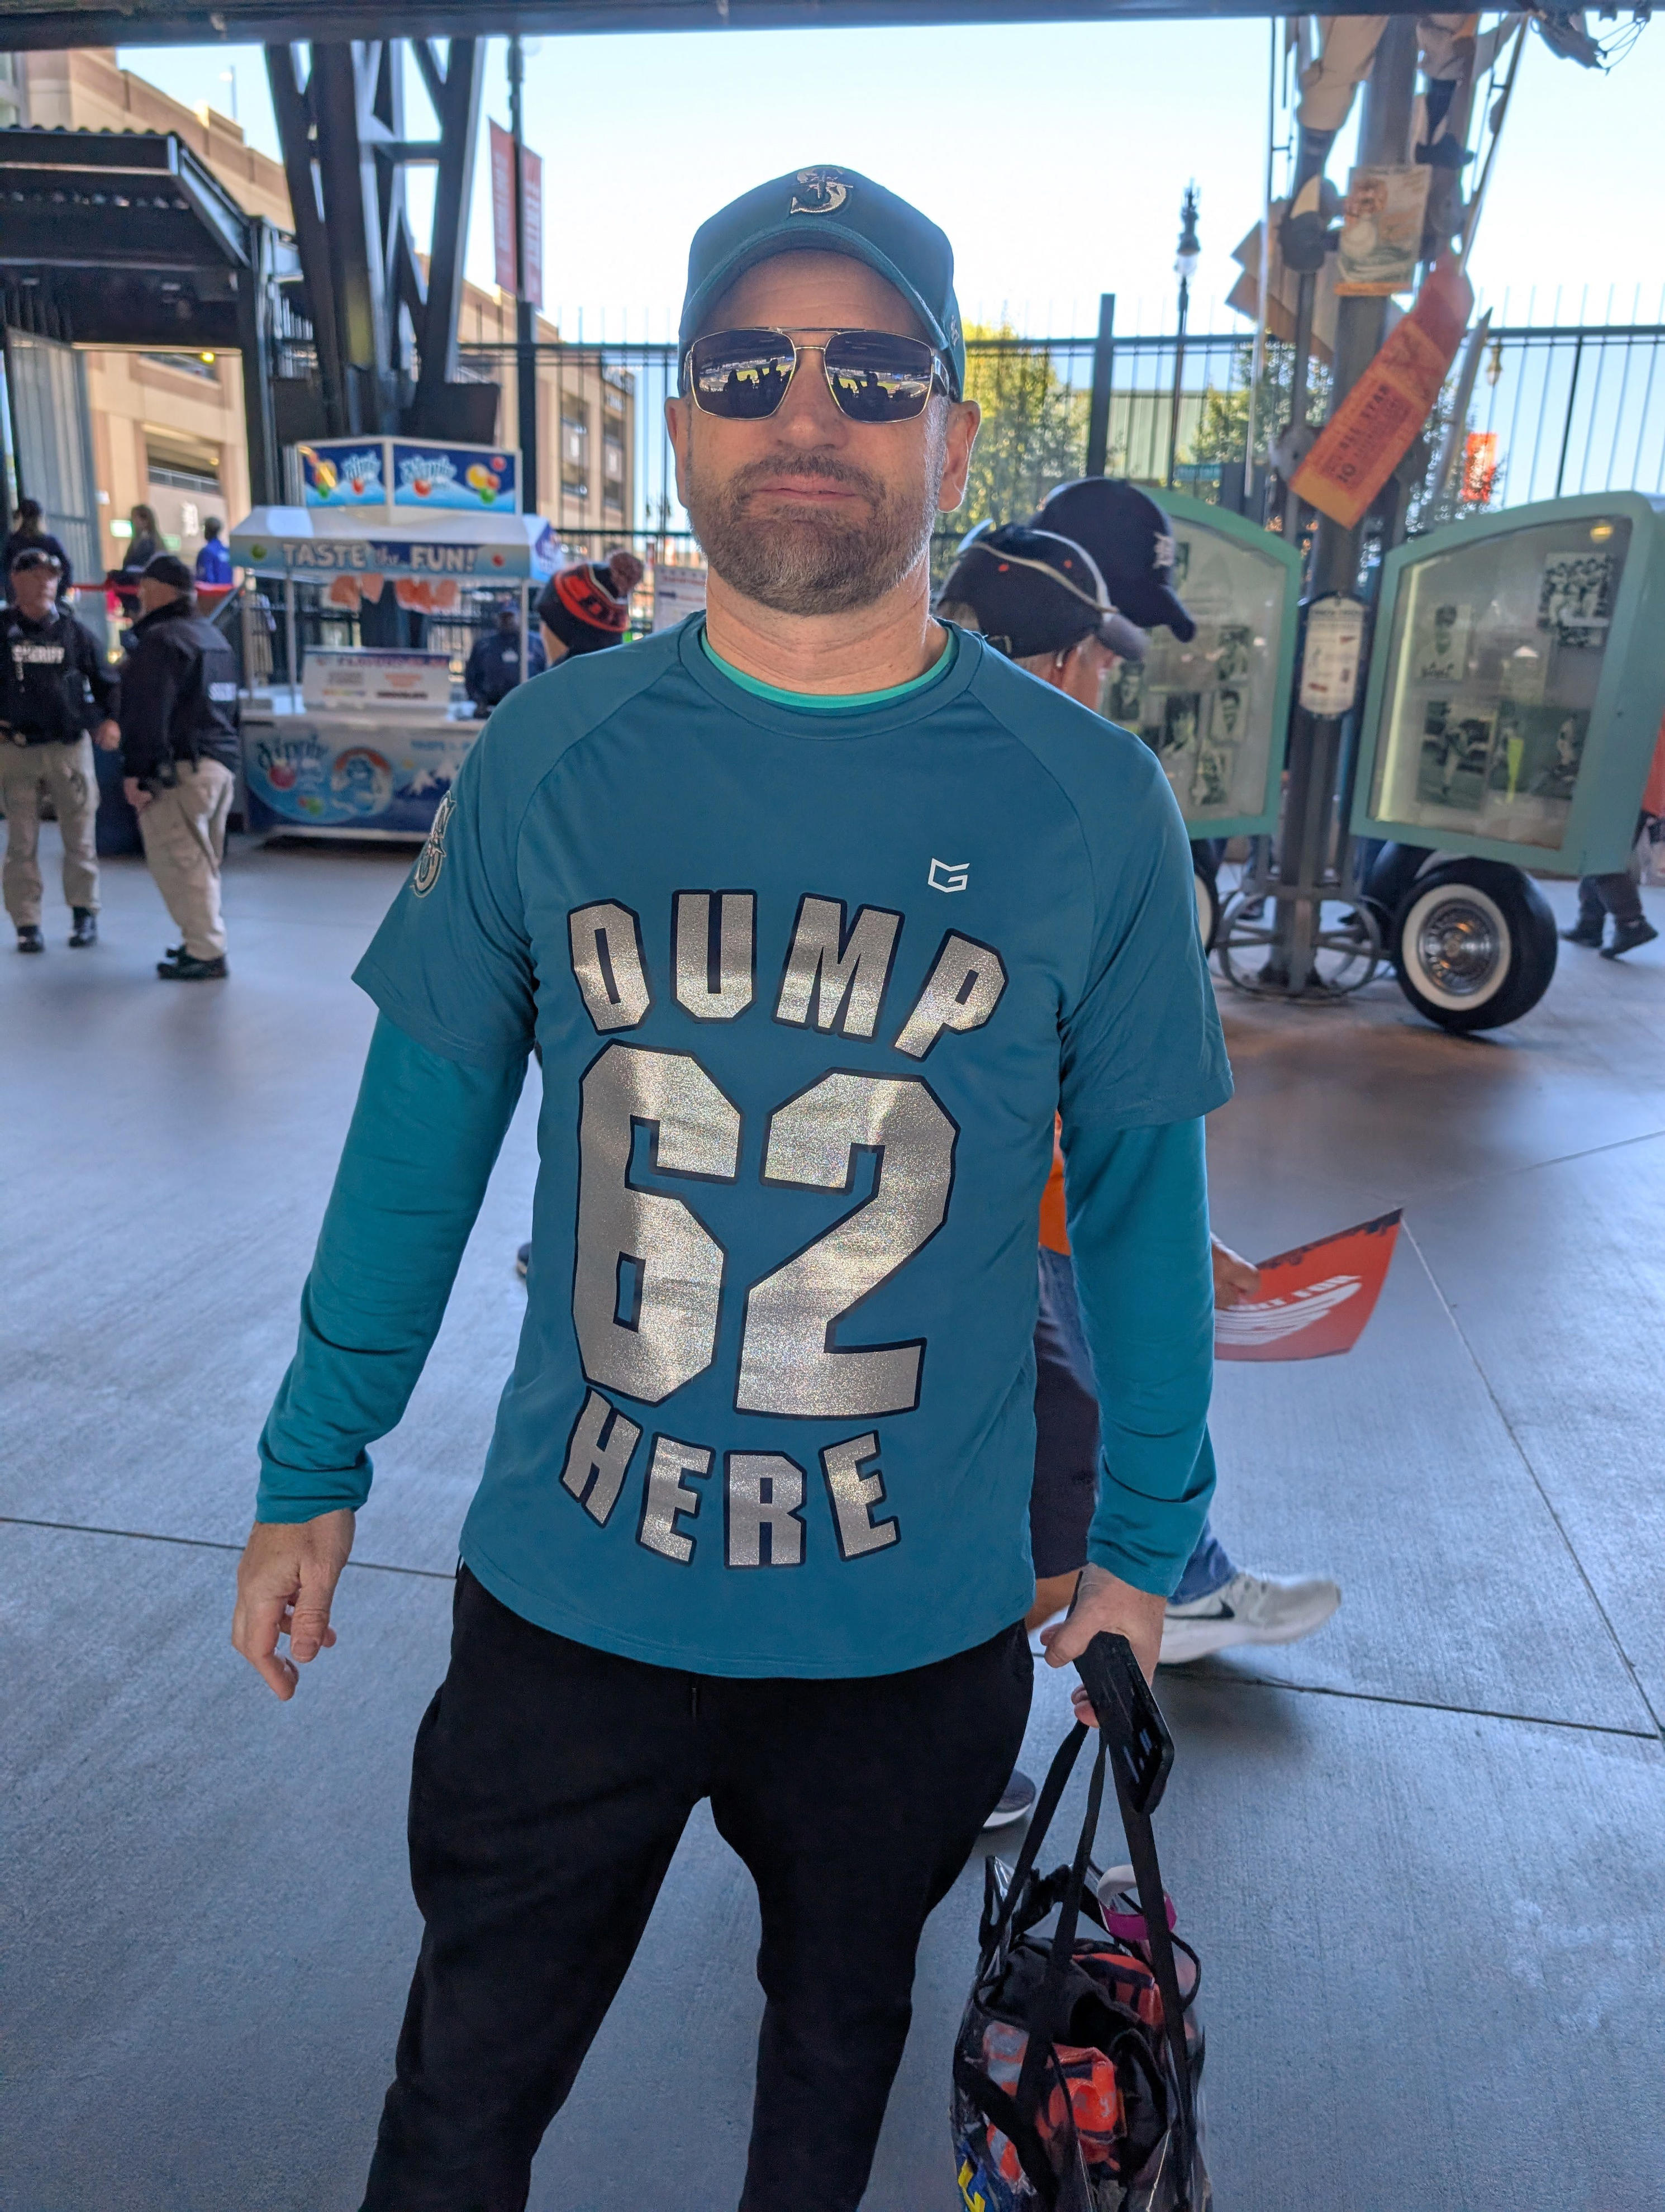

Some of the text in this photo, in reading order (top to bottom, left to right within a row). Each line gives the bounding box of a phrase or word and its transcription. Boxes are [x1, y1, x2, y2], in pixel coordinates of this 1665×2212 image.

[282, 543, 367, 569] TASTE
[408, 545, 478, 573] FUN!
[567, 889, 1009, 1062] DUMP
[572, 1038, 961, 1421] 62
[559, 1385, 902, 1569] HERE
